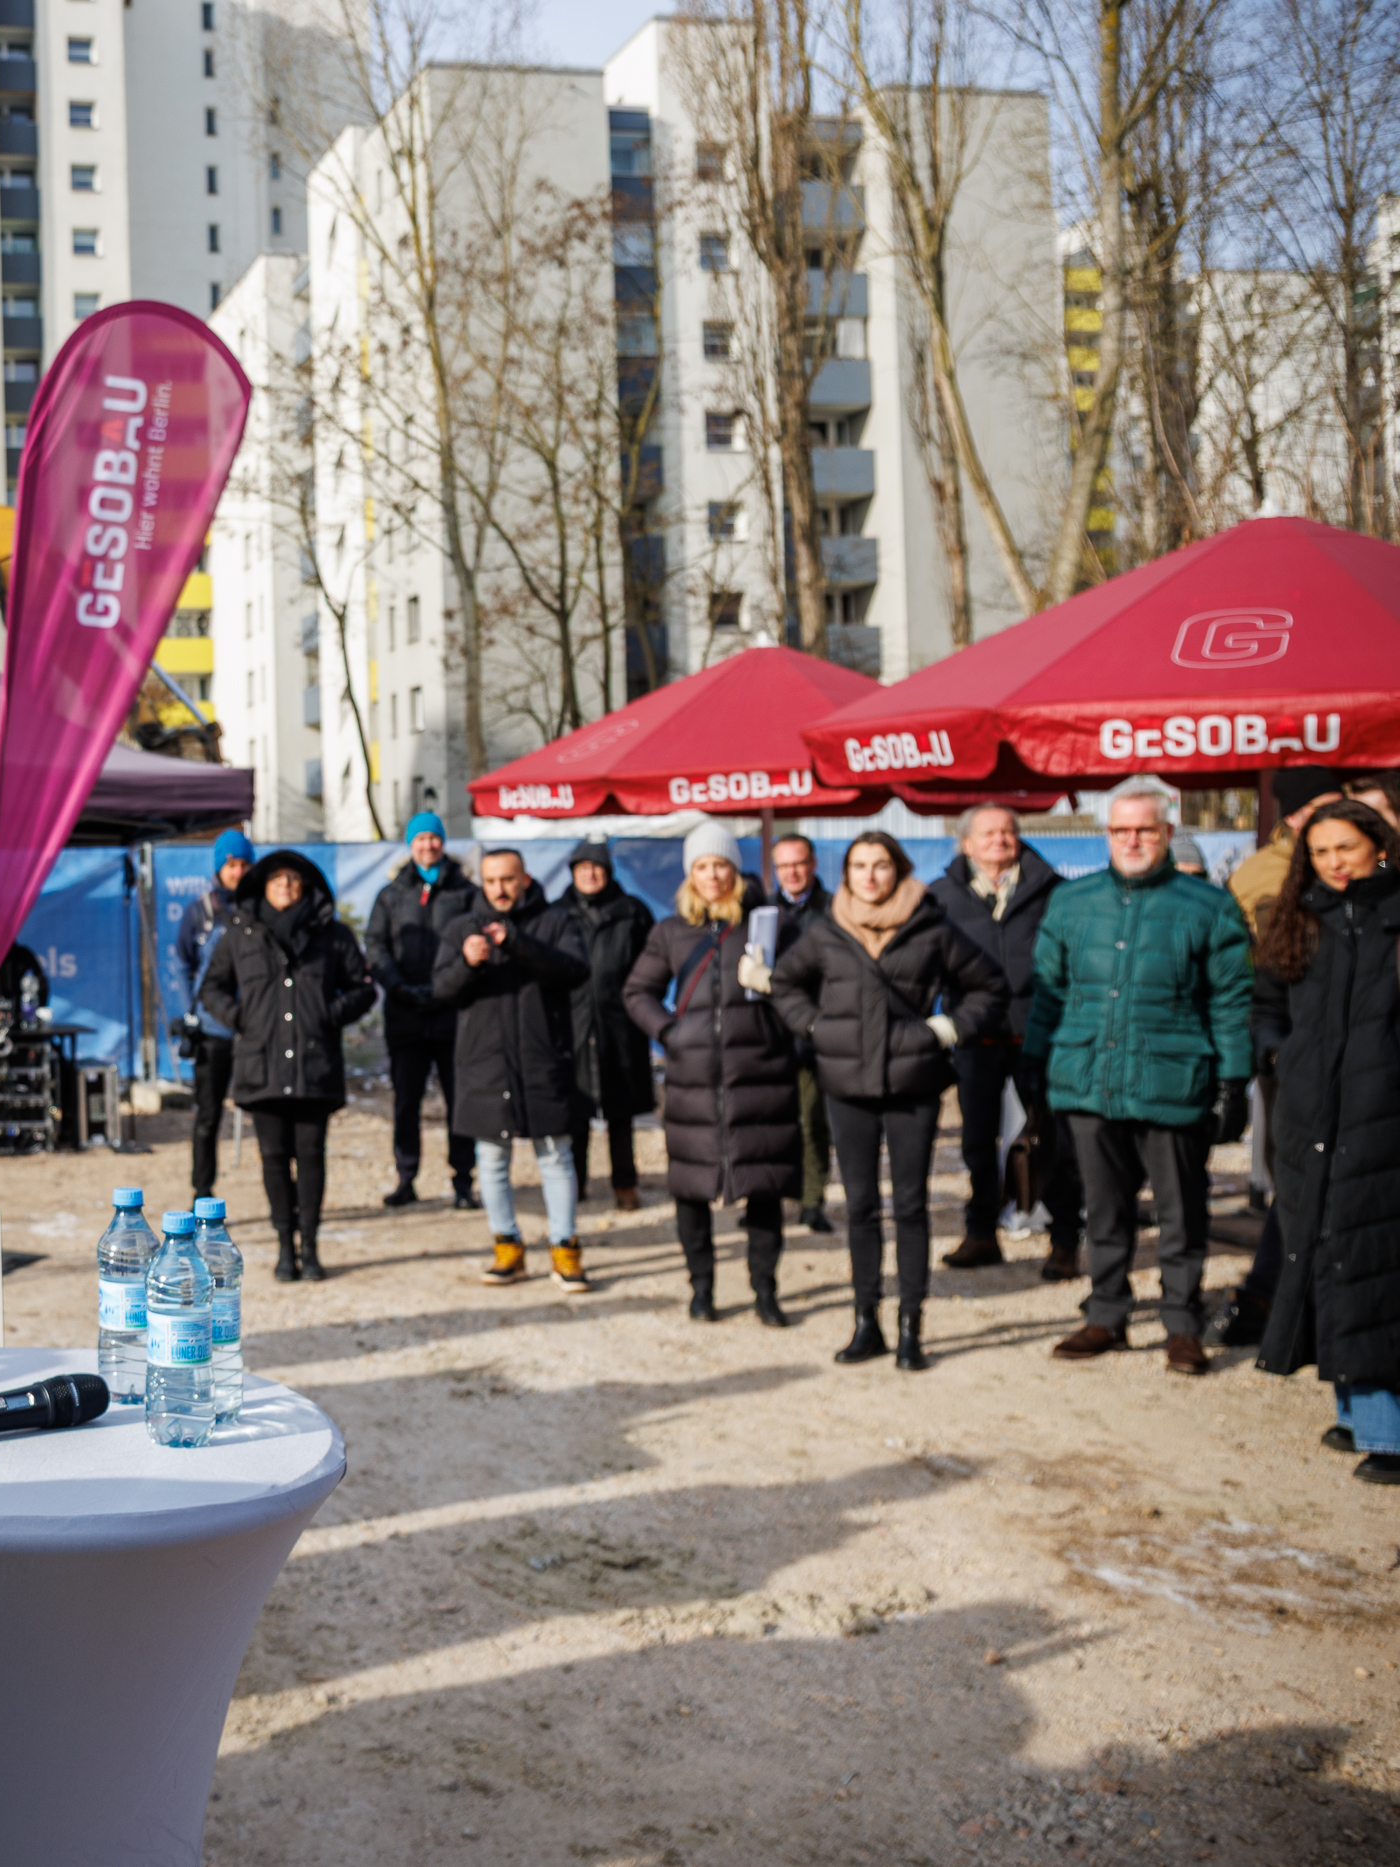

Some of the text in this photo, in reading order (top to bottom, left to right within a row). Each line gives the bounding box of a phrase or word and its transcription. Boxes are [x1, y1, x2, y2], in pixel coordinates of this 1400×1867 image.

[76, 375, 148, 629] GESOBAU
[141, 445, 166, 508] wohnt
[134, 513, 155, 551] Hier
